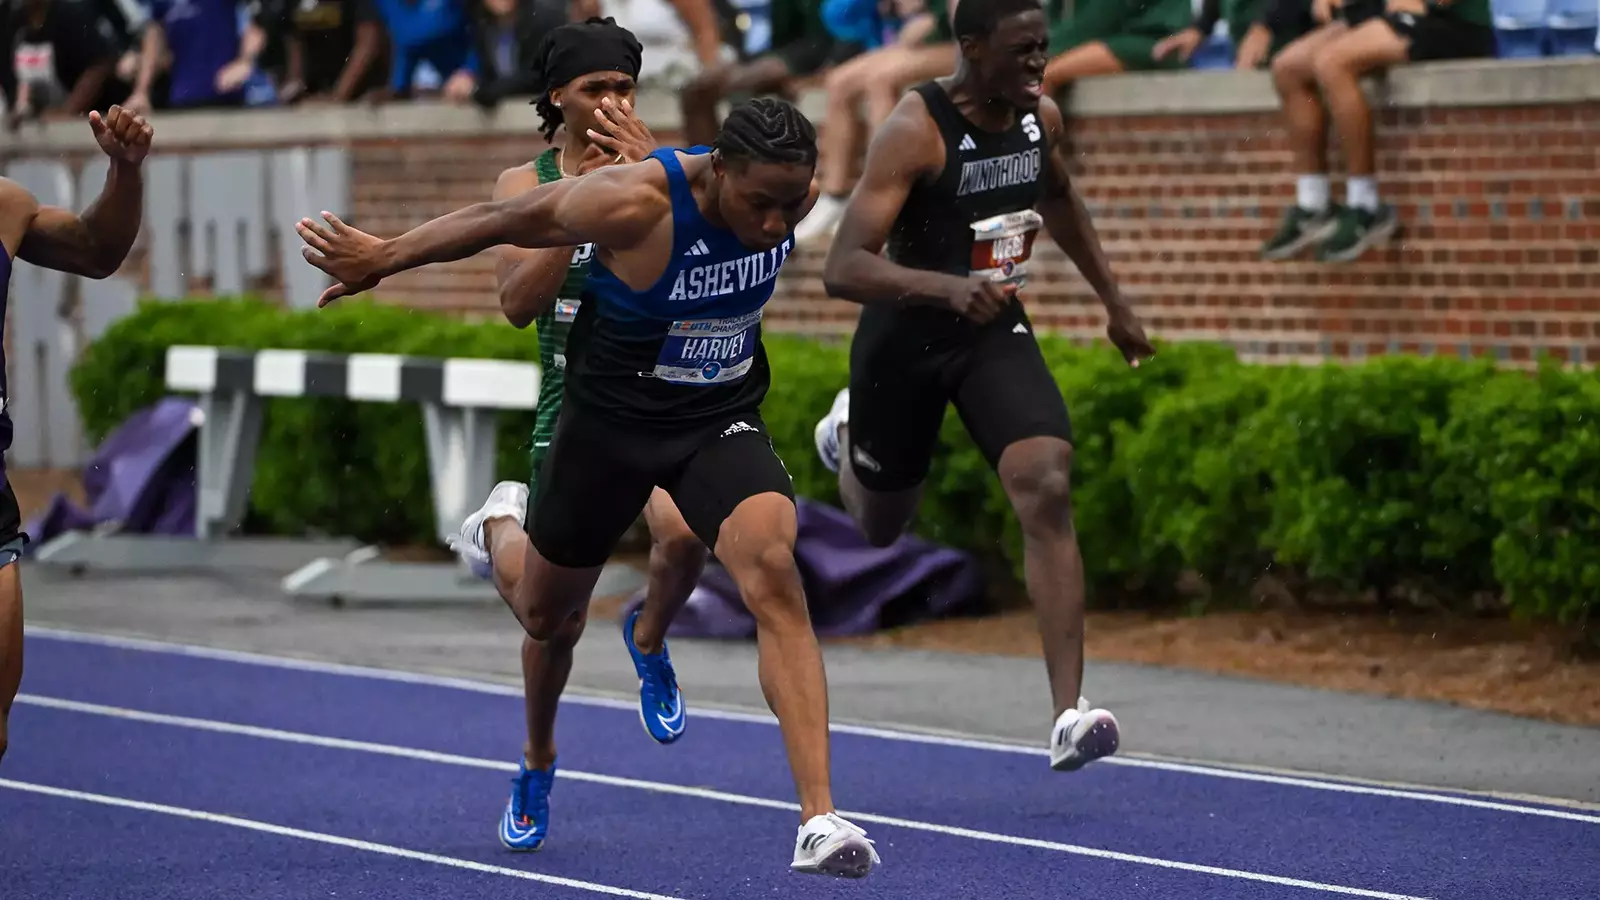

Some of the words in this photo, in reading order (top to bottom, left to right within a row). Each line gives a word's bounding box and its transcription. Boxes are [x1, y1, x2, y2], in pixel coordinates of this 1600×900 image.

[957, 147, 1041, 197] WINTHROP
[668, 239, 790, 301] ASHEVILLE
[681, 330, 747, 359] HARVEY
